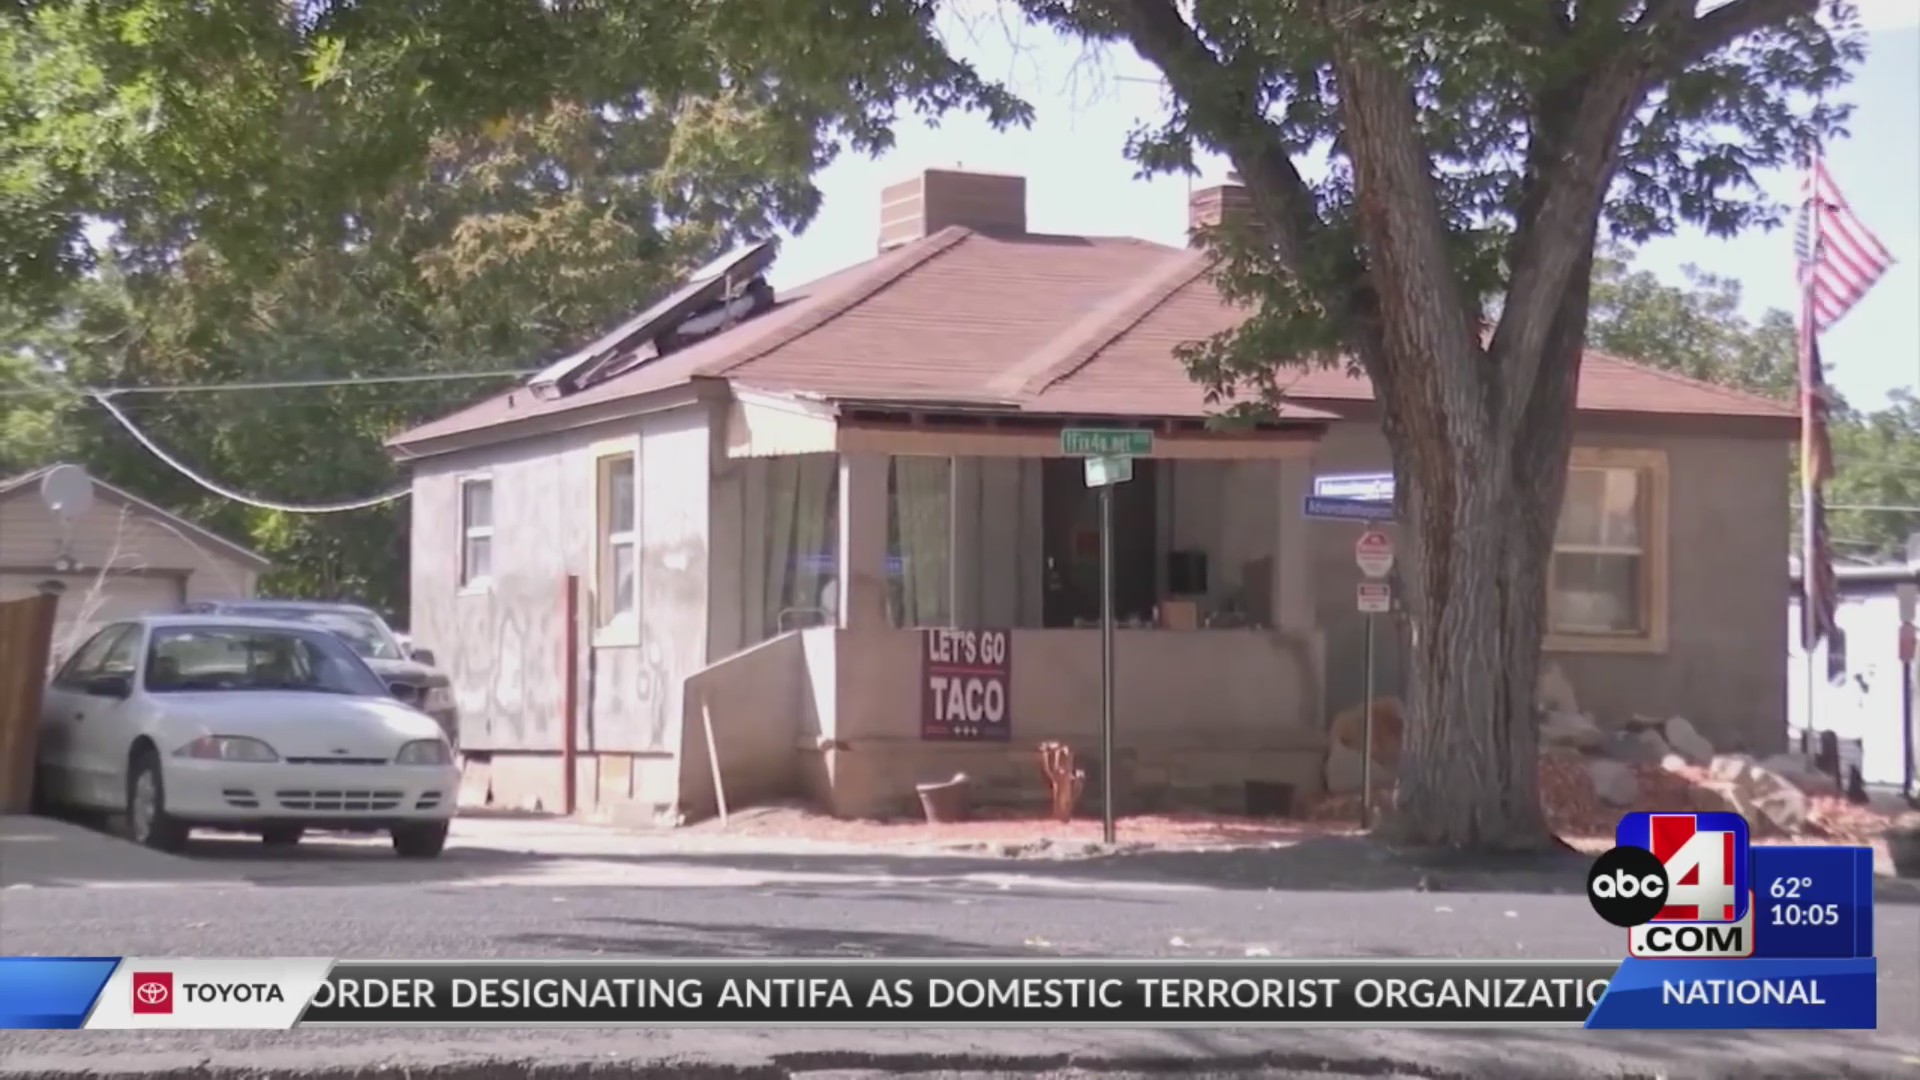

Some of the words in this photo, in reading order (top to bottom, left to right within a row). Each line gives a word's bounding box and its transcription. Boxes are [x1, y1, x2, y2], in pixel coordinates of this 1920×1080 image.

[928, 629, 977, 663] LET'S
[981, 631, 1006, 665] GO
[929, 677, 1004, 722] TACO
